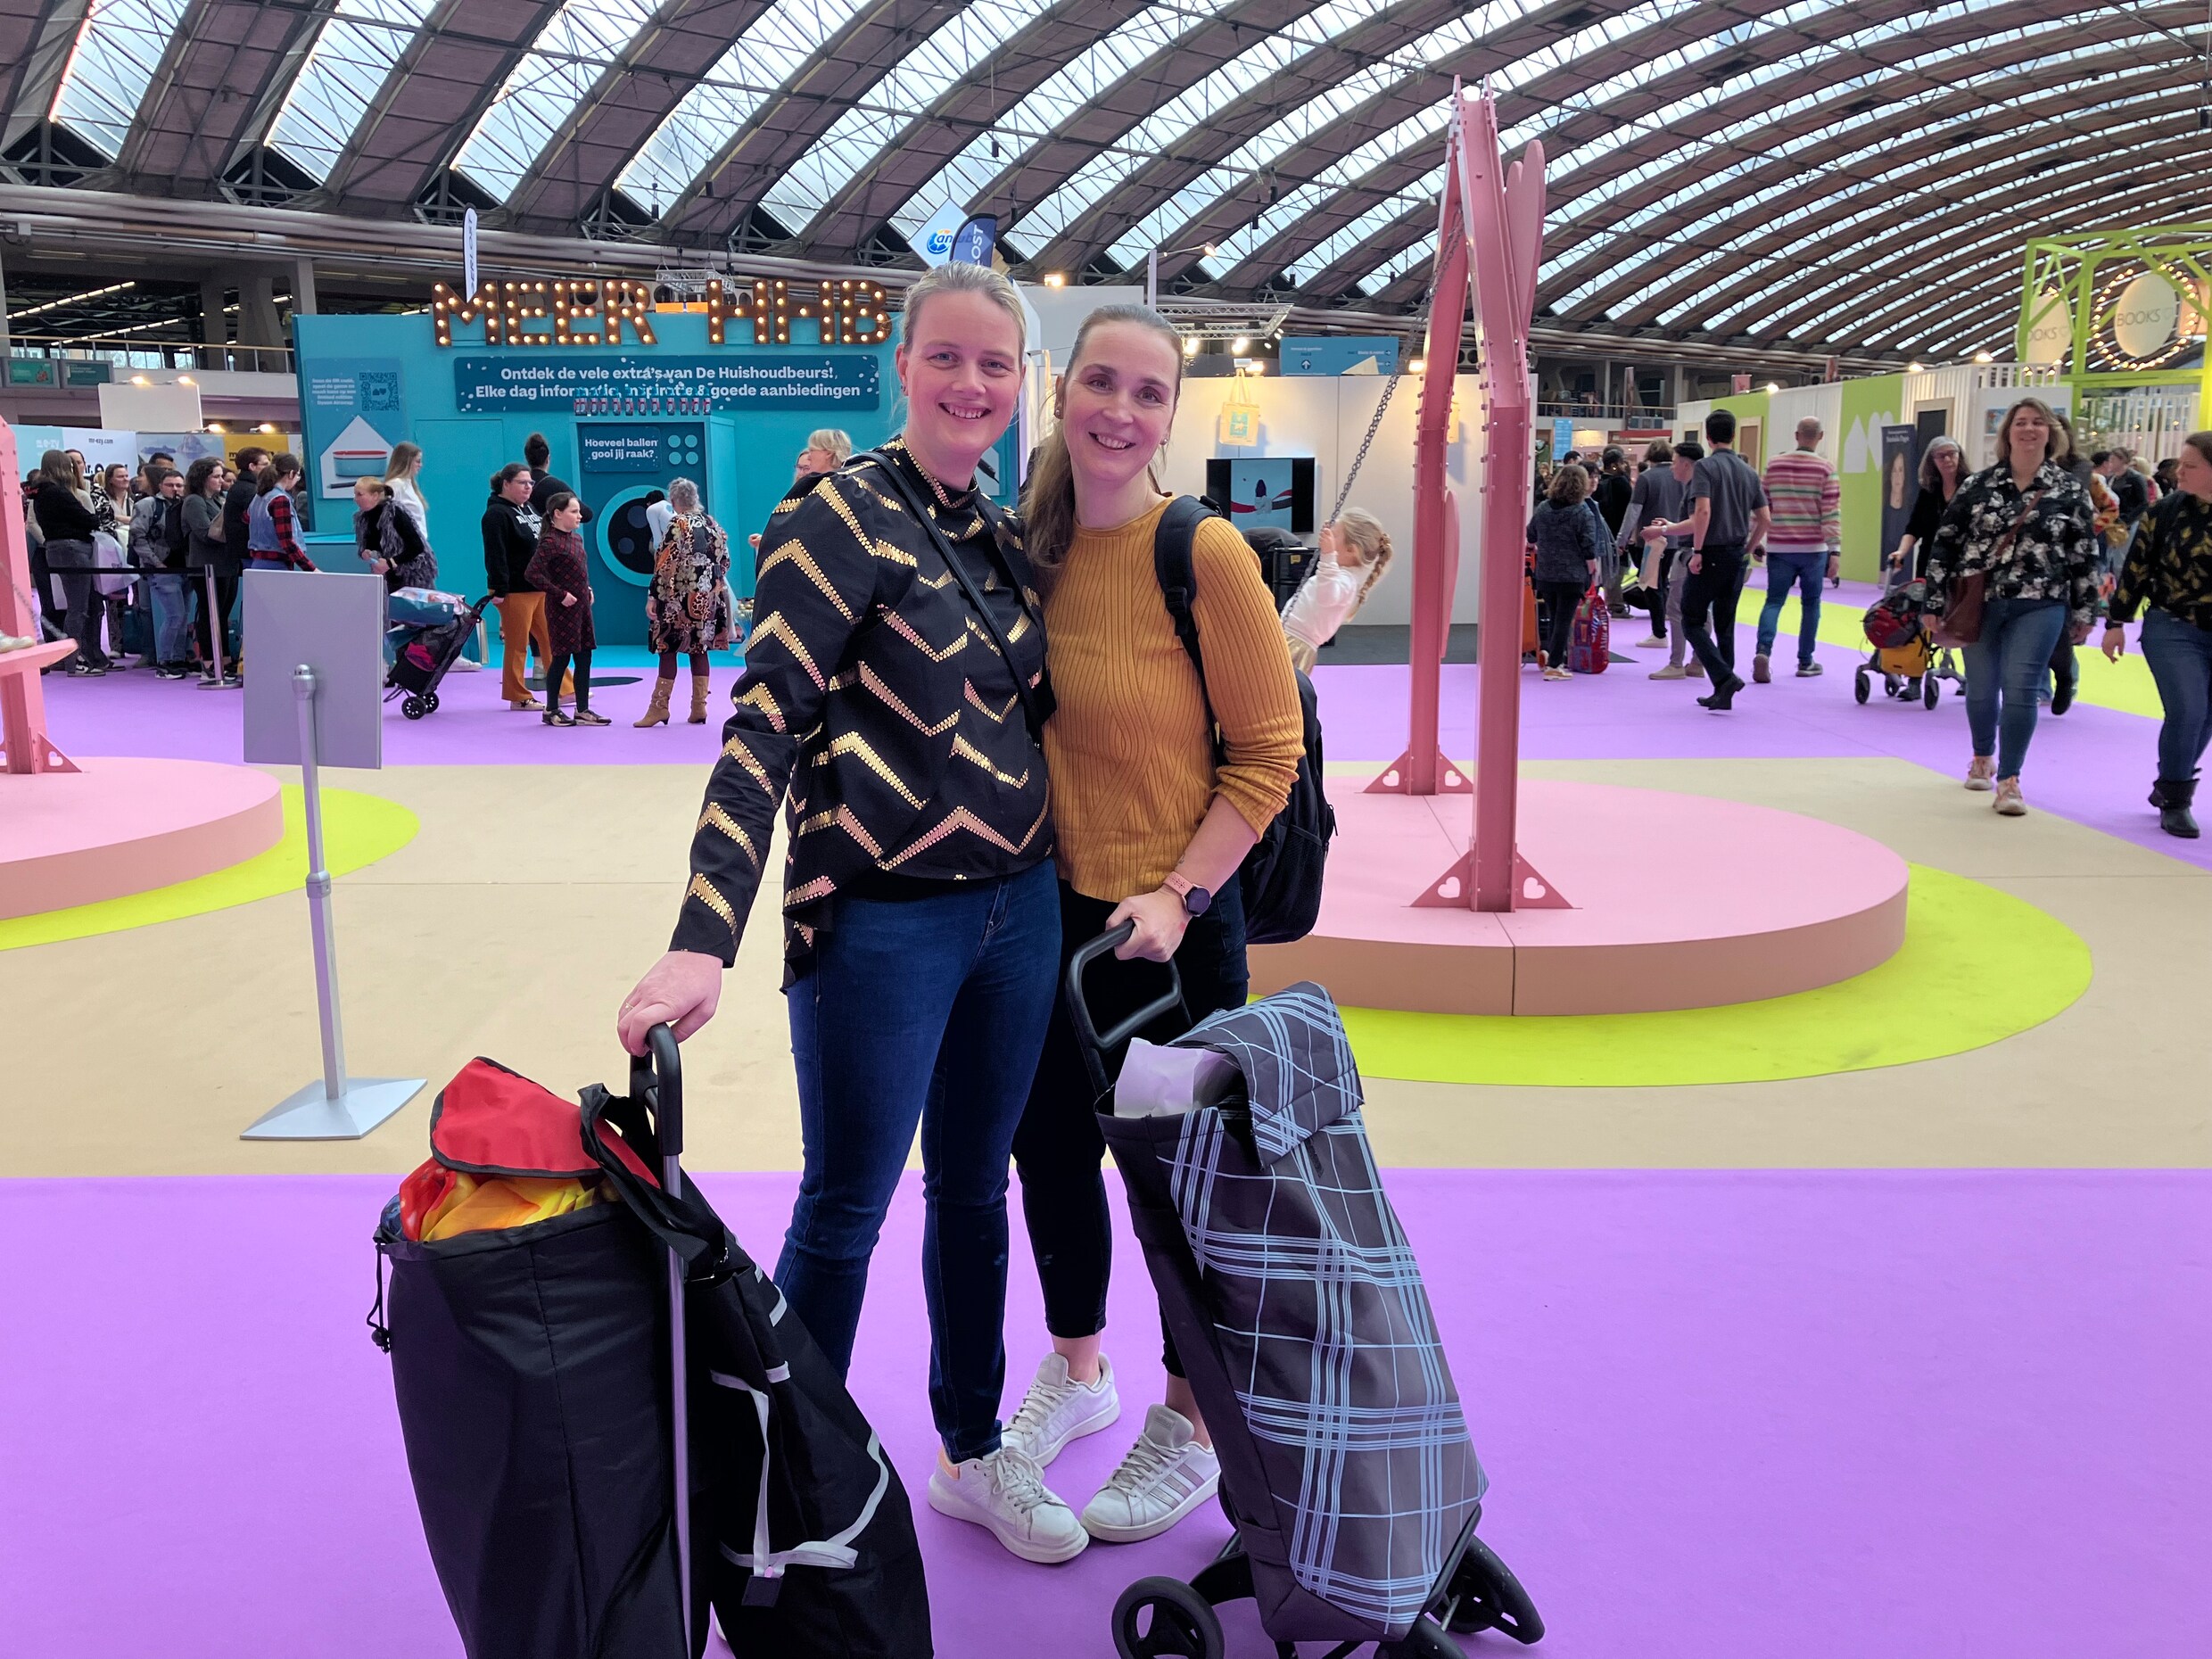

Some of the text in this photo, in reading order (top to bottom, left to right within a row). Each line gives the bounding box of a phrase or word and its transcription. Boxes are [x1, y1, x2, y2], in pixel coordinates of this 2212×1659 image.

[432, 279, 892, 346] MEER HHB
[2117, 310, 2160, 326] BOOKS
[500, 367, 555, 380] Ontdek
[557, 367, 576, 380] de
[579, 367, 609, 380] vele
[664, 368, 693, 379] van
[696, 367, 715, 379] De
[718, 366, 833, 379] Huishoudbeurs!
[475, 384, 506, 398] Elke
[509, 384, 537, 400] dag
[710, 384, 756, 400] goede
[760, 384, 860, 400] aanbiedingen
[585, 438, 658, 447] Hoeveel ballen
[591, 449, 655, 460] gooi jij raak?
